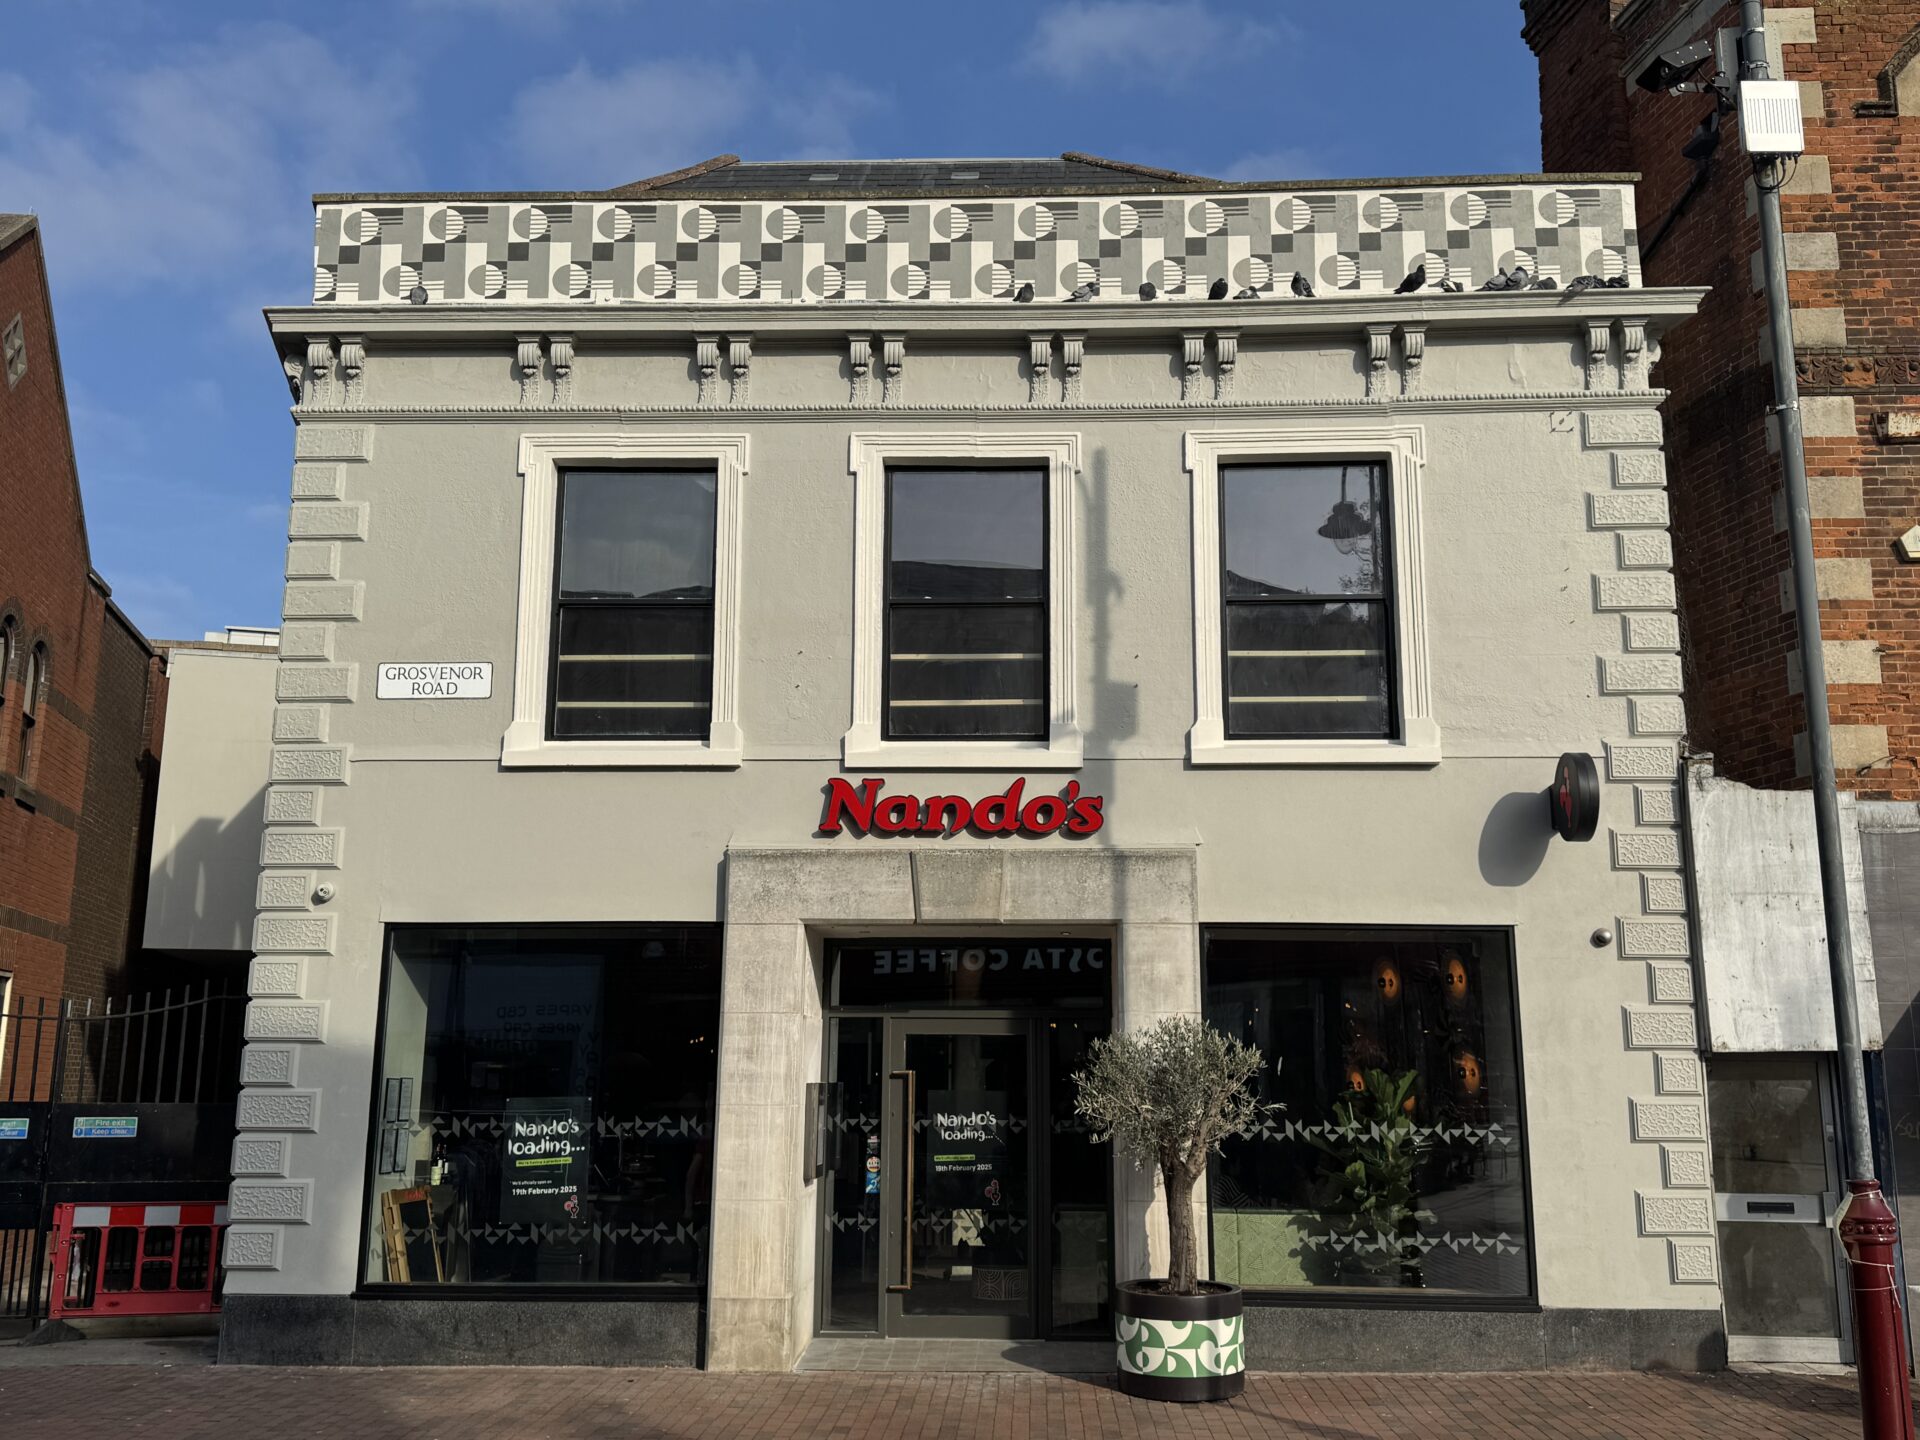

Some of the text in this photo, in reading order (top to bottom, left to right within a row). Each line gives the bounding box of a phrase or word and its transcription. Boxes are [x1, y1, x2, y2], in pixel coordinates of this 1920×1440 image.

[385, 666, 484, 681] GROSVENOR
[411, 681, 458, 695] ROAD
[819, 776, 1104, 834] Nando's
[95, 1119, 126, 1127] Fire exit
[937, 1111, 997, 1127] Nando's
[91, 1127, 128, 1136] Keep clear
[515, 1118, 579, 1138] Nando's
[941, 1127, 993, 1141] loading...
[508, 1136, 585, 1155] loading...
[948, 1164, 976, 1172] February
[511, 1185, 577, 1196] 19th February 2025
